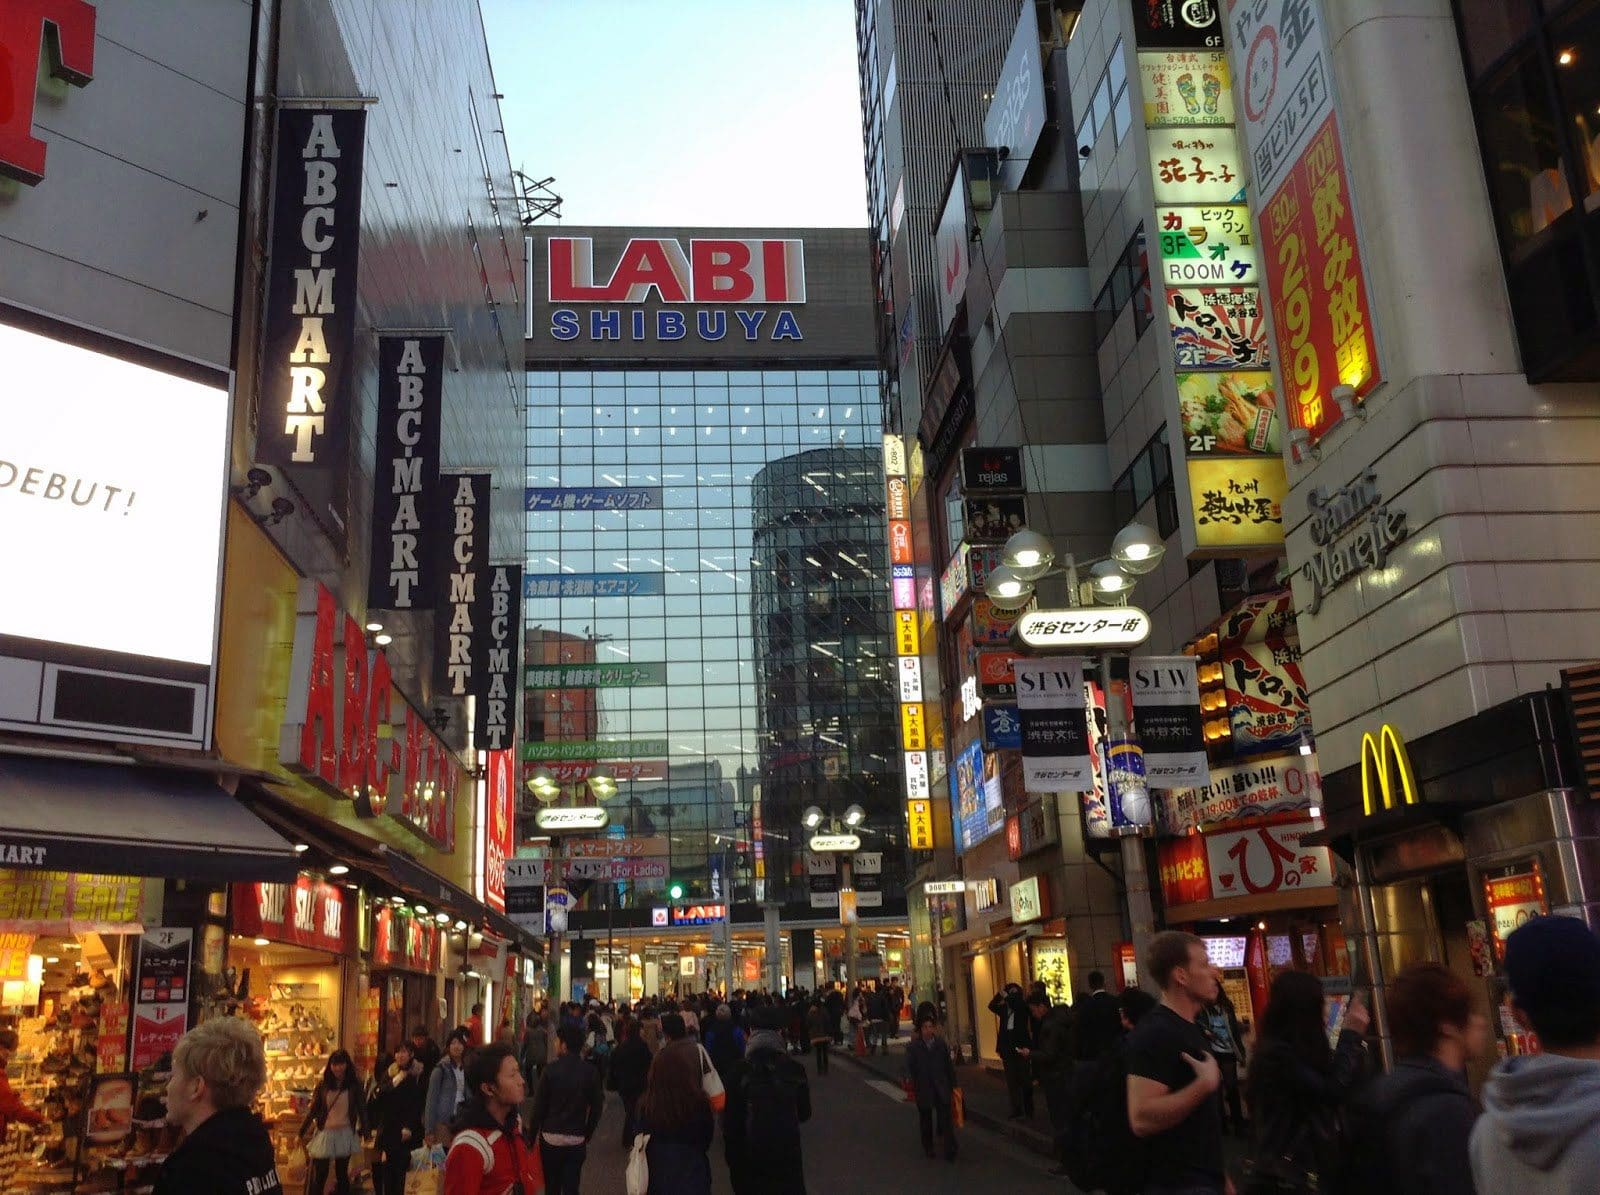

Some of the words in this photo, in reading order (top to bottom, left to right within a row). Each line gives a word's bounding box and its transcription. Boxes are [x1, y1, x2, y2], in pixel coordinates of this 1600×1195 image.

[1205, 36, 1221, 47] 6F
[1162, 235, 1187, 254] 3F
[548, 237, 806, 303] LABI
[1169, 263, 1225, 280] ROOM
[285, 114, 341, 462] ABC-MART
[550, 309, 804, 341] SHIBUYA
[1178, 349, 1207, 366] 2F
[1189, 435, 1217, 451] 2F
[389, 340, 426, 608] ABC-MART
[977, 471, 1009, 486] rejas
[447, 477, 476, 695] ABC-MART
[1025, 618, 1142, 636] 渋谷センター街
[486, 567, 511, 749] ABC-MART
[159, 931, 174, 945] 2F
